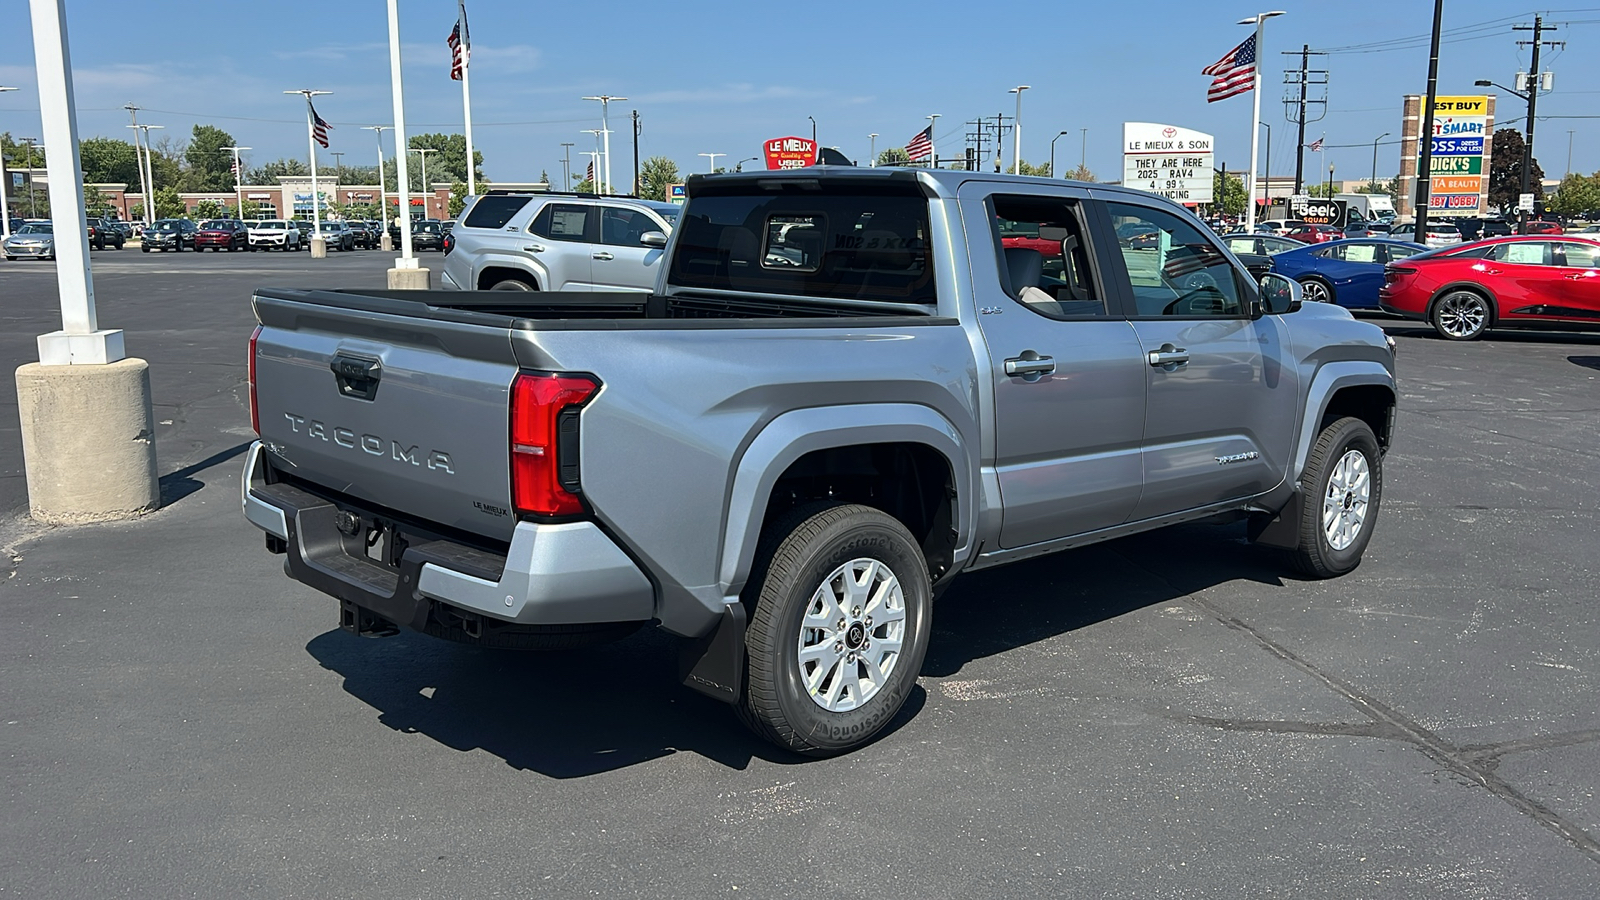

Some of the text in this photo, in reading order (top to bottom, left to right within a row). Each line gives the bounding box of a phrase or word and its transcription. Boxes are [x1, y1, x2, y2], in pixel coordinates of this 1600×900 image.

[1434, 102, 1481, 110] EST BUY
[1422, 122, 1483, 135] TSMART
[769, 139, 812, 152] LE MIEUX
[1129, 140, 1209, 150] LE MIEUX & SON
[1420, 140, 1456, 152] OSS
[1135, 158, 1203, 168] THEY ARE HERE
[1430, 157, 1470, 171] DICK'S
[1137, 169, 1193, 179] 2025 RAV4
[1432, 178, 1446, 188] TA
[1153, 190, 1189, 199] ANCING
[1430, 196, 1477, 206] BBY LOBBY
[284, 412, 455, 474] TACOMA
[473, 501, 482, 509] LE
[483, 503, 508, 516] MIEUX
